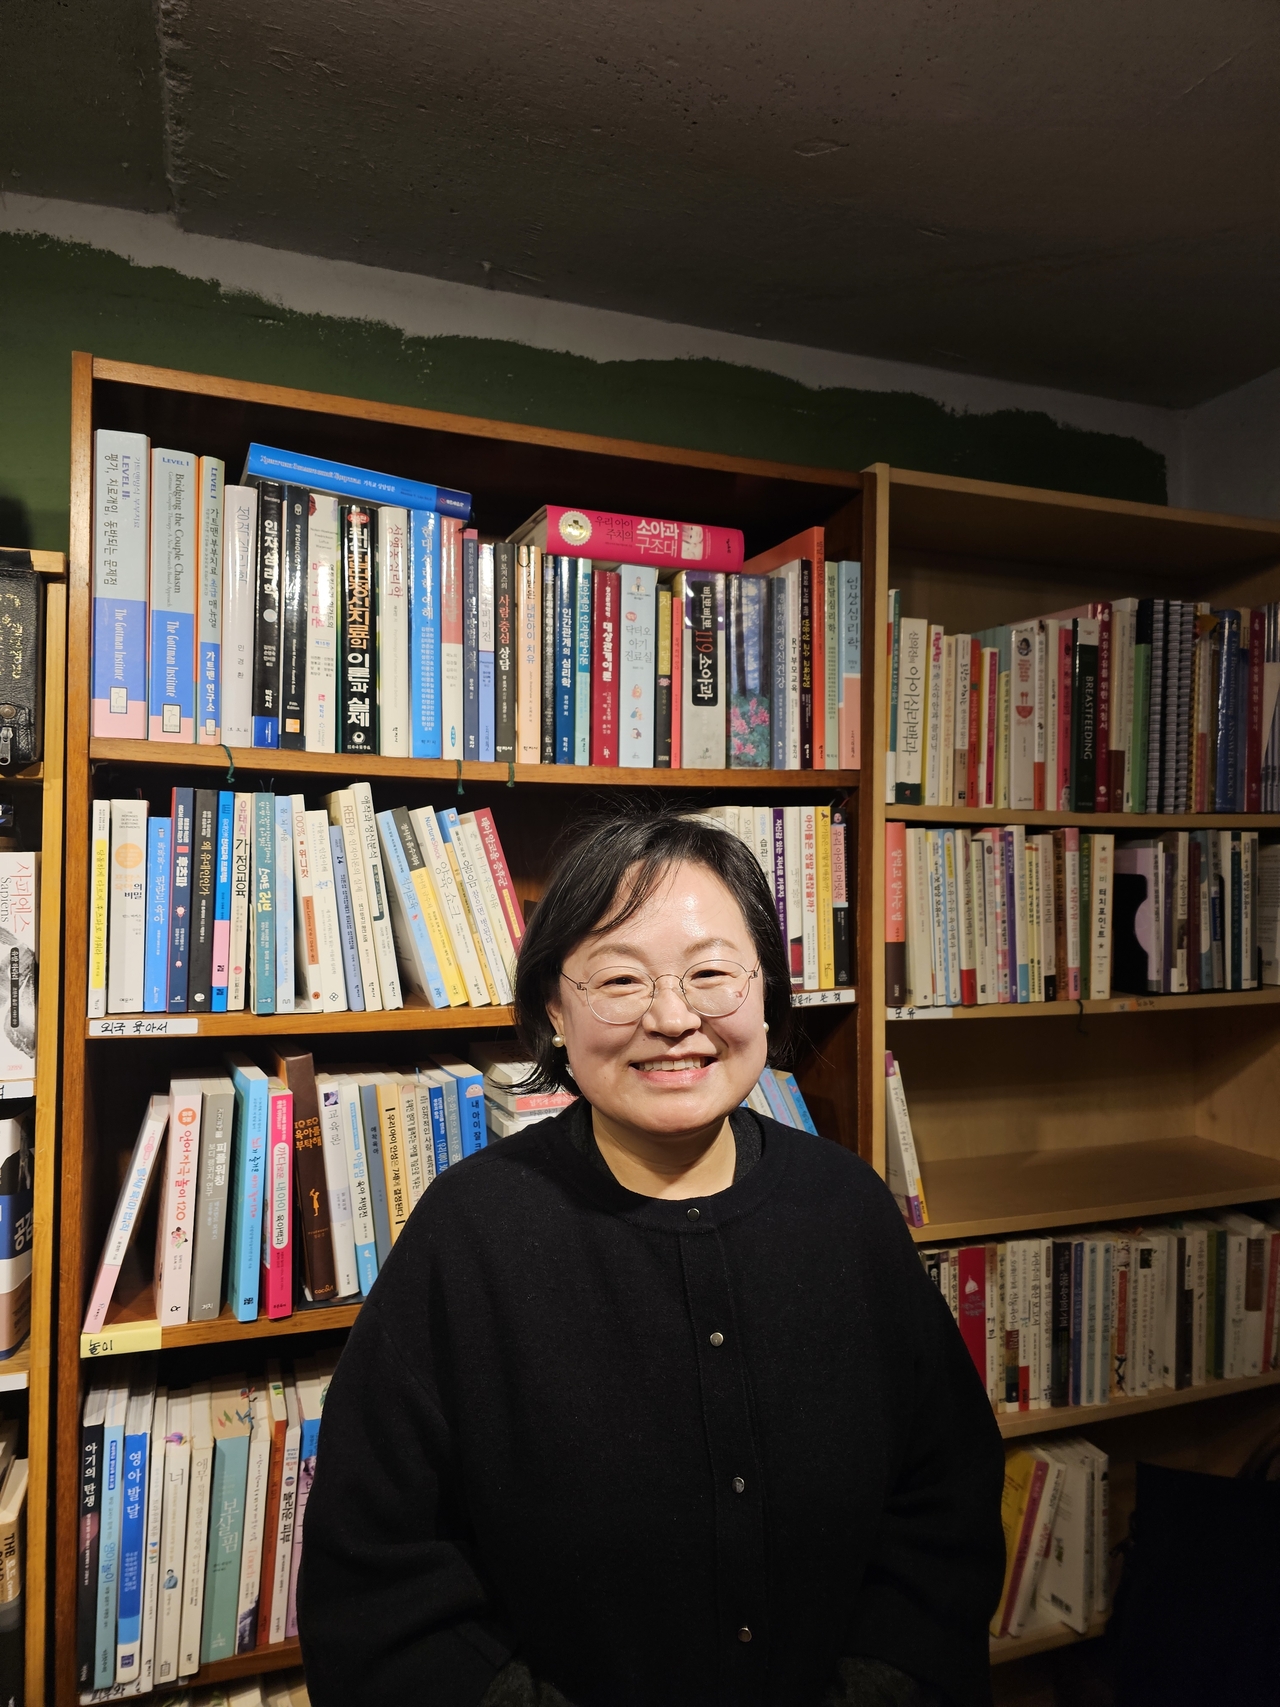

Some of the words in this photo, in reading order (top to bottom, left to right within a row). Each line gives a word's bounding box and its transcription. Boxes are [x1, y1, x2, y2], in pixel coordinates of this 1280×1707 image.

[104, 453, 119, 474] 평가,
[122, 455, 131, 487] LEVEL
[162, 457, 185, 467] LEVEL
[173, 473, 185, 510] Bridging
[210, 467, 218, 493] LEVEL
[174, 512, 185, 526] the
[210, 508, 219, 538] 가트맨
[594, 515, 614, 528] 우리
[615, 518, 634, 531] 아이
[635, 519, 680, 540] 소아과
[103, 520, 118, 556] 동반되는
[174, 530, 184, 561] Couple
[605, 529, 634, 543] 주치의
[635, 536, 678, 558] 구조대
[103, 559, 118, 586] 문제점
[174, 563, 184, 594] Chasm
[114, 609, 127, 620] The
[828, 575, 836, 632] 발달심리학
[847, 576, 860, 650] 임상심리학
[166, 621, 180, 634] The
[526, 603, 536, 640] 내면아이
[562, 608, 573, 656] 인간관계의
[625, 625, 651, 636] 닥터오
[114, 621, 127, 650] Gottman
[579, 615, 590, 666] 인지발달이론
[629, 638, 648, 651] 아기
[695, 630, 713, 653] 119
[908, 631, 919, 664] 신의진의
[166, 635, 180, 665] Gottman
[499, 647, 511, 671] 상담
[526, 644, 536, 664] 치유
[602, 621, 613, 682] 대상관계이론
[624, 651, 652, 663] 진료실
[775, 638, 786, 689] 정신건강
[1100, 632, 1110, 678] 모유수유를
[114, 651, 126, 681] Institute
[205, 651, 216, 681] 가트맨
[347, 652, 370, 693] 이론과
[561, 658, 572, 688] 심리학
[696, 654, 714, 700] 소아과
[165, 667, 179, 697] Institute
[1100, 681, 1109, 700] 위한
[205, 683, 216, 712] 연구소
[902, 666, 921, 756] 아이심리백과
[347, 697, 370, 727] 실제
[1083, 676, 1094, 760] BREASTFEEDING
[1099, 704, 1109, 731] 지침서
[1227, 720, 1236, 760] ANSWER
[343, 805, 357, 836] REBT와
[361, 795, 373, 822] 애착과
[294, 810, 306, 838] 100%
[775, 819, 783, 839] 자신감
[805, 814, 814, 850] 아이들은
[832, 829, 842, 846] 우리
[201, 841, 212, 850] 왜
[364, 824, 379, 858] 정신분석
[425, 816, 441, 860] NurtureShock
[775, 841, 783, 854] 있는
[298, 848, 309, 879] 위니캇
[336, 855, 344, 864] 24
[349, 839, 362, 875] 인지이론의
[776, 856, 784, 876] 자녀로
[805, 852, 814, 870] 정말
[833, 847, 843, 873] 아이의
[175, 856, 189, 888] 후츠파
[198, 852, 211, 896] 유대인인가
[436, 861, 453, 889] 양육
[493, 861, 509, 887] 증후군
[1, 876, 12, 923] Sapiens
[15, 861, 34, 933] 사피엔스
[124, 892, 143, 900] 비밀
[777, 878, 785, 898] 키우자
[805, 873, 815, 914] 괜찮을까?
[834, 874, 844, 900] 머릿속
[891, 880, 903, 910] 잘사는
[443, 892, 462, 919] 쇼크
[891, 912, 903, 921] 법
[833, 991, 842, 1003] 책
[895, 1007, 916, 1019] 모유
[100, 1021, 126, 1035] 외국
[132, 1020, 168, 1035] 육아서
[471, 1100, 480, 1109] 내
[294, 1119, 306, 1129] IQ
[305, 1117, 319, 1127] EQ
[294, 1126, 321, 1140] 육아를
[386, 1114, 396, 1129] 우리
[472, 1112, 481, 1129] 아이
[179, 1130, 194, 1153] 언어
[295, 1136, 322, 1151] 부탁해
[388, 1129, 398, 1145] 아이
[451, 1137, 460, 1152] 나온
[473, 1132, 482, 1141] 잘
[177, 1154, 192, 1176] 자극
[274, 1146, 287, 1180] 까다로운
[353, 1151, 365, 1179] 아들맘
[390, 1145, 400, 1168] 인성은
[174, 1178, 190, 1199] 놀이
[274, 1181, 287, 1192] 내
[356, 1180, 366, 1195] 육아
[176, 1201, 187, 1221] 120
[274, 1192, 287, 1213] 아이
[358, 1196, 368, 1219] 처방전
[394, 1188, 404, 1217] 결정된다
[273, 1214, 285, 1245] 육아백과
[84, 1442, 98, 1479] 아기의
[83, 1482, 97, 1508] 탄생
[126, 1450, 142, 1520] 영아발달
[281, 1491, 295, 1521] 놀라운
[215, 1498, 240, 1554] 보살핌
[279, 1523, 292, 1545] 피부
[4, 1532, 16, 1561] THE
[101, 1542, 116, 1584] 영아놀이
